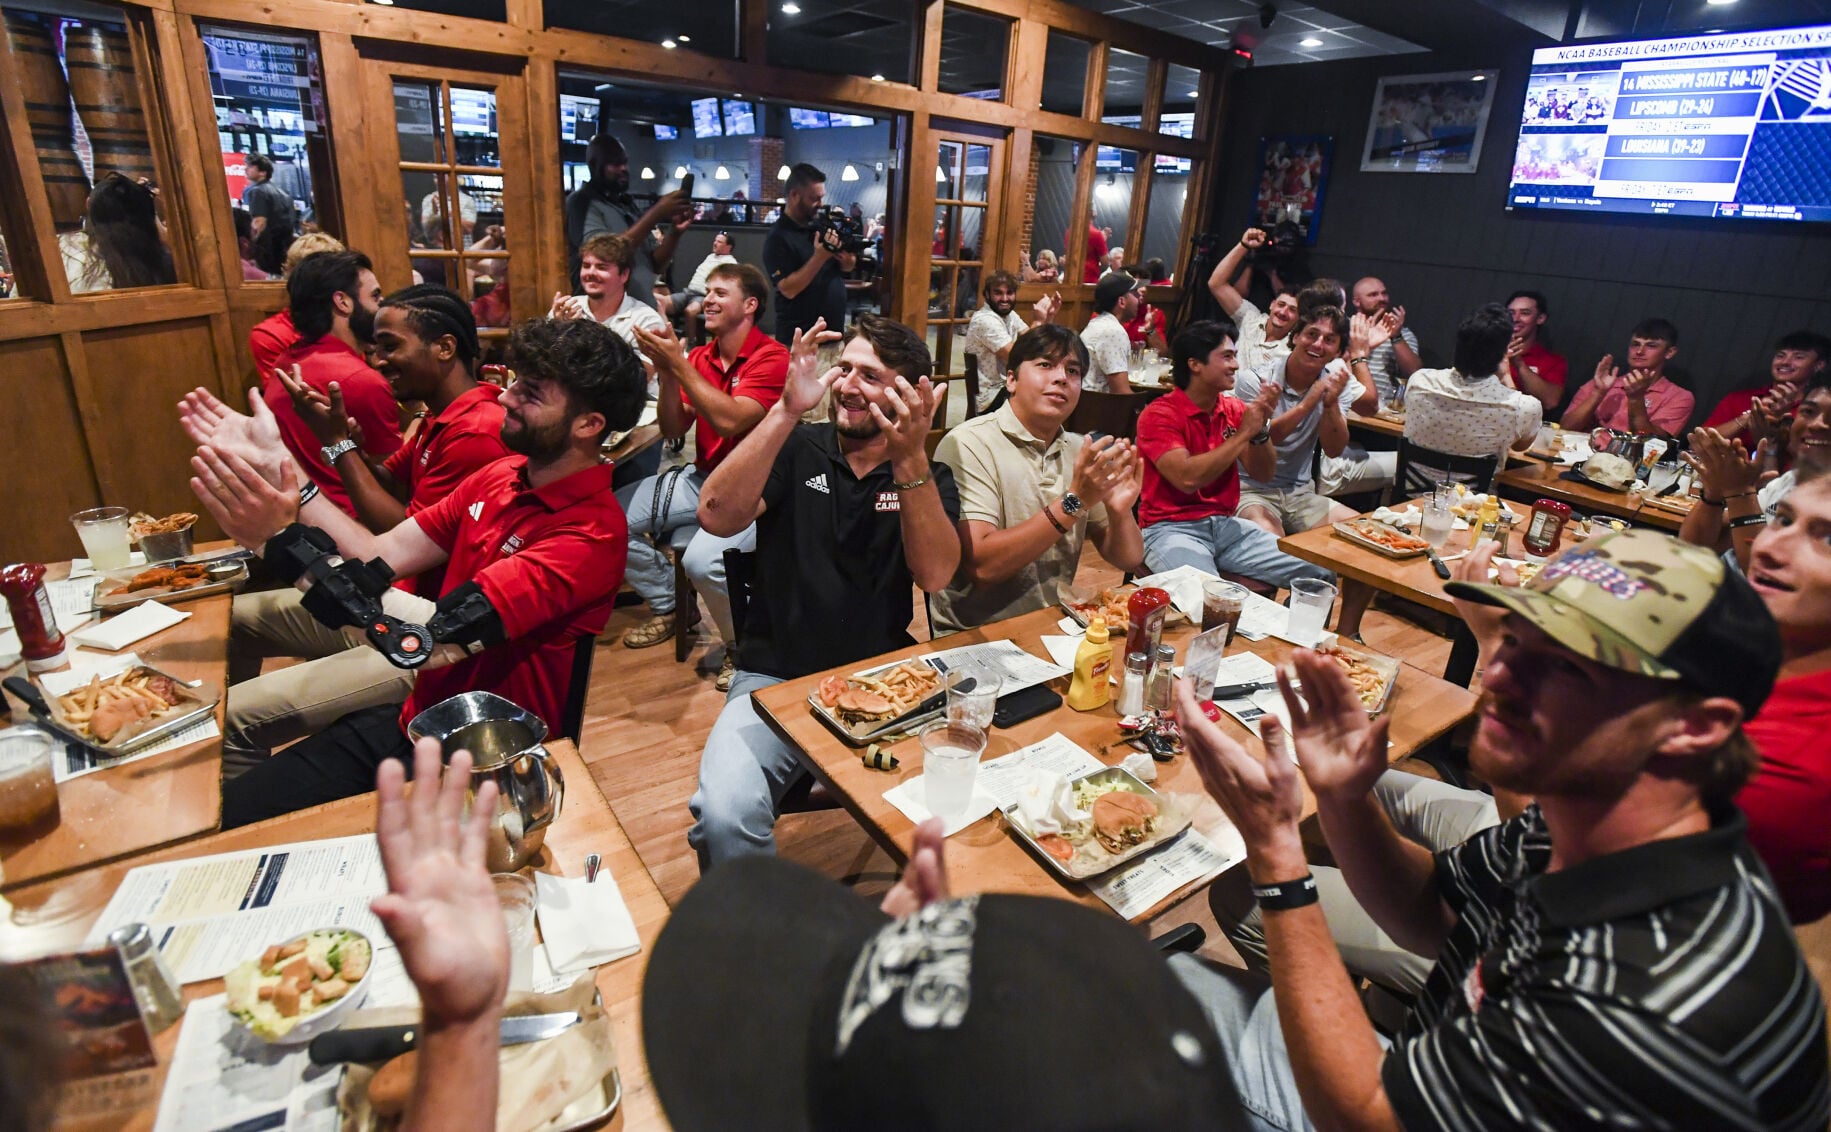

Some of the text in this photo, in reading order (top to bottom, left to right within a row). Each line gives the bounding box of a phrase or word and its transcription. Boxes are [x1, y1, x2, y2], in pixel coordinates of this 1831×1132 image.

[1558, 50, 1585, 59] NCAA
[1588, 46, 1640, 58] BASEBALL
[1644, 38, 1739, 55] CHAMPIONSHIP
[1741, 32, 1812, 48] SELECTION
[1623, 78, 1635, 90] 14
[1635, 73, 1696, 90] MISSISSIPPI
[1695, 70, 1729, 88] STATE
[1630, 100, 1678, 115] LIPSCOMB
[1621, 138, 1669, 153] LOUISIANA
[805, 480, 830, 494] adidas
